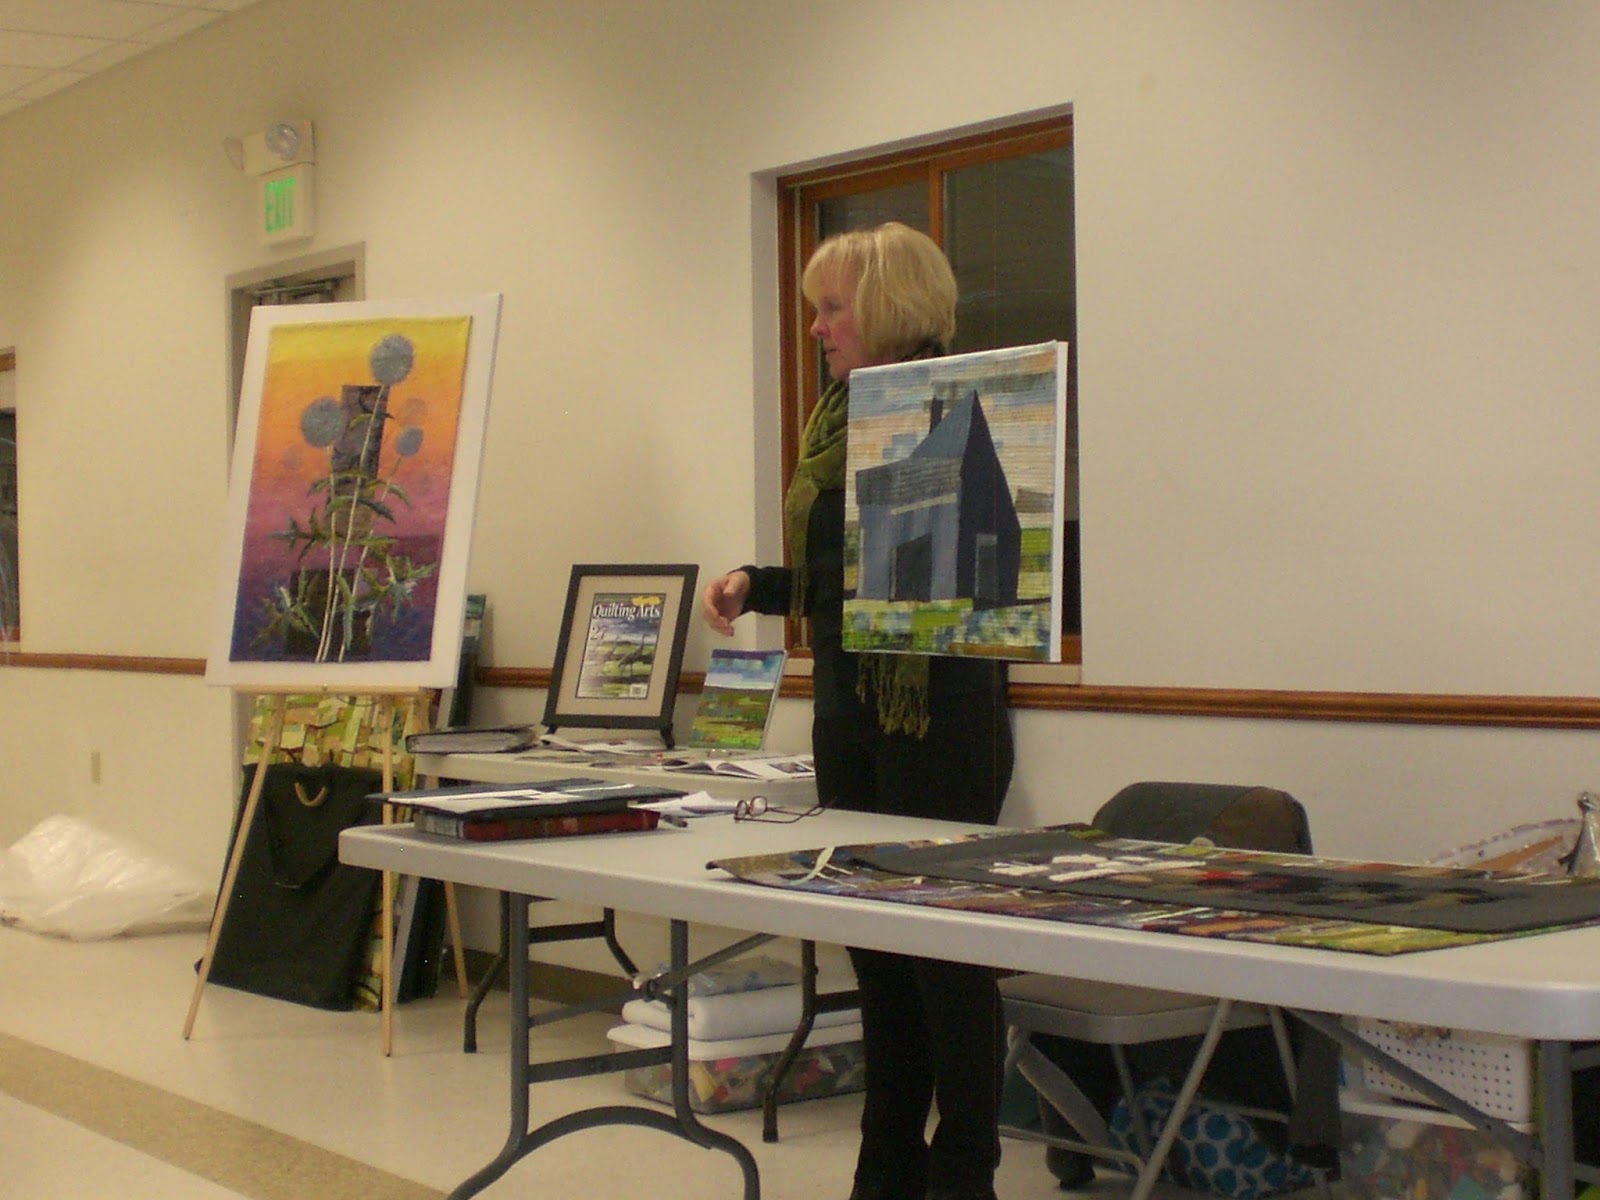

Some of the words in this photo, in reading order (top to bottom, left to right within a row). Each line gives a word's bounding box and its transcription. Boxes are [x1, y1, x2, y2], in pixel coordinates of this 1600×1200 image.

[265, 177, 295, 233] EXIT
[593, 603, 636, 621] Quilting
[637, 603, 660, 618] Arts
